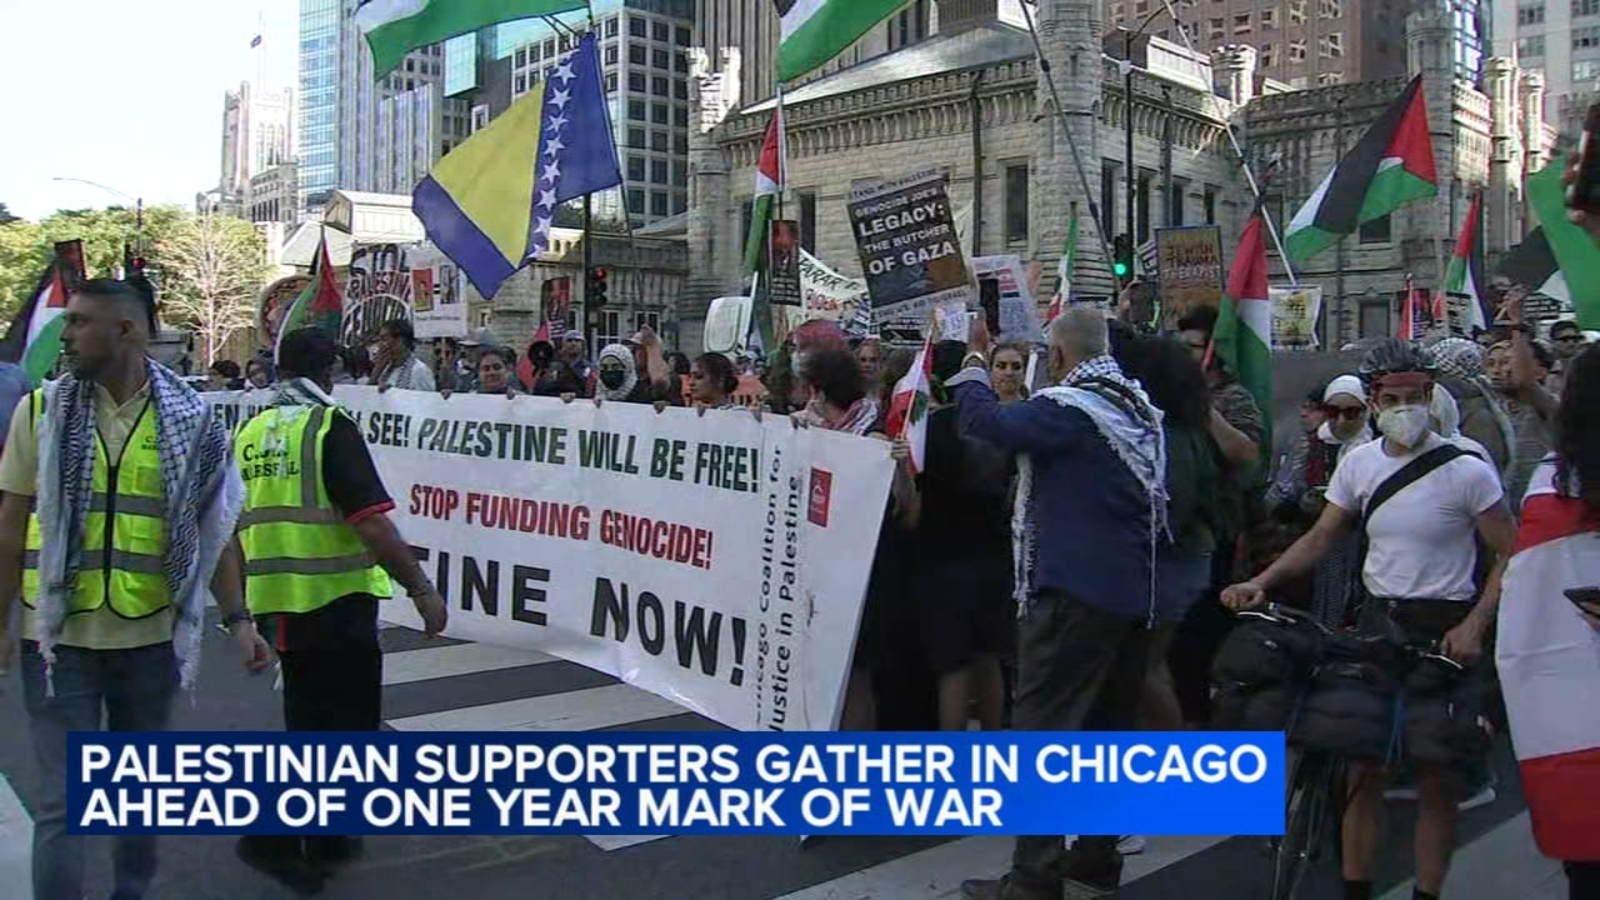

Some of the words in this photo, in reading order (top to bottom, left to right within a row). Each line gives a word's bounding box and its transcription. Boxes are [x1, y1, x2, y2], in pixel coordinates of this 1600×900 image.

[855, 197, 909, 217] GENOCIDE
[859, 202, 944, 236] LEGACY:
[864, 239, 891, 254] THE
[893, 224, 951, 247] BUTCHER
[869, 256, 897, 275] OF
[902, 241, 956, 266] GAZA
[368, 411, 411, 447] SEE!
[418, 417, 567, 465] PALESTINE
[577, 429, 639, 474] WILL
[650, 438, 687, 481] BE
[695, 443, 758, 493] FREE!
[410, 484, 459, 520] STOP
[466, 493, 590, 541] FUNDING
[600, 509, 713, 570] GENOCIDE!
[758, 493, 777, 613] Coalition
[769, 445, 782, 483] for
[779, 476, 800, 603] Palestine
[403, 543, 550, 626] INE
[590, 576, 747, 686] NOW!
[774, 612, 793, 637] in
[768, 645, 790, 731] Justice
